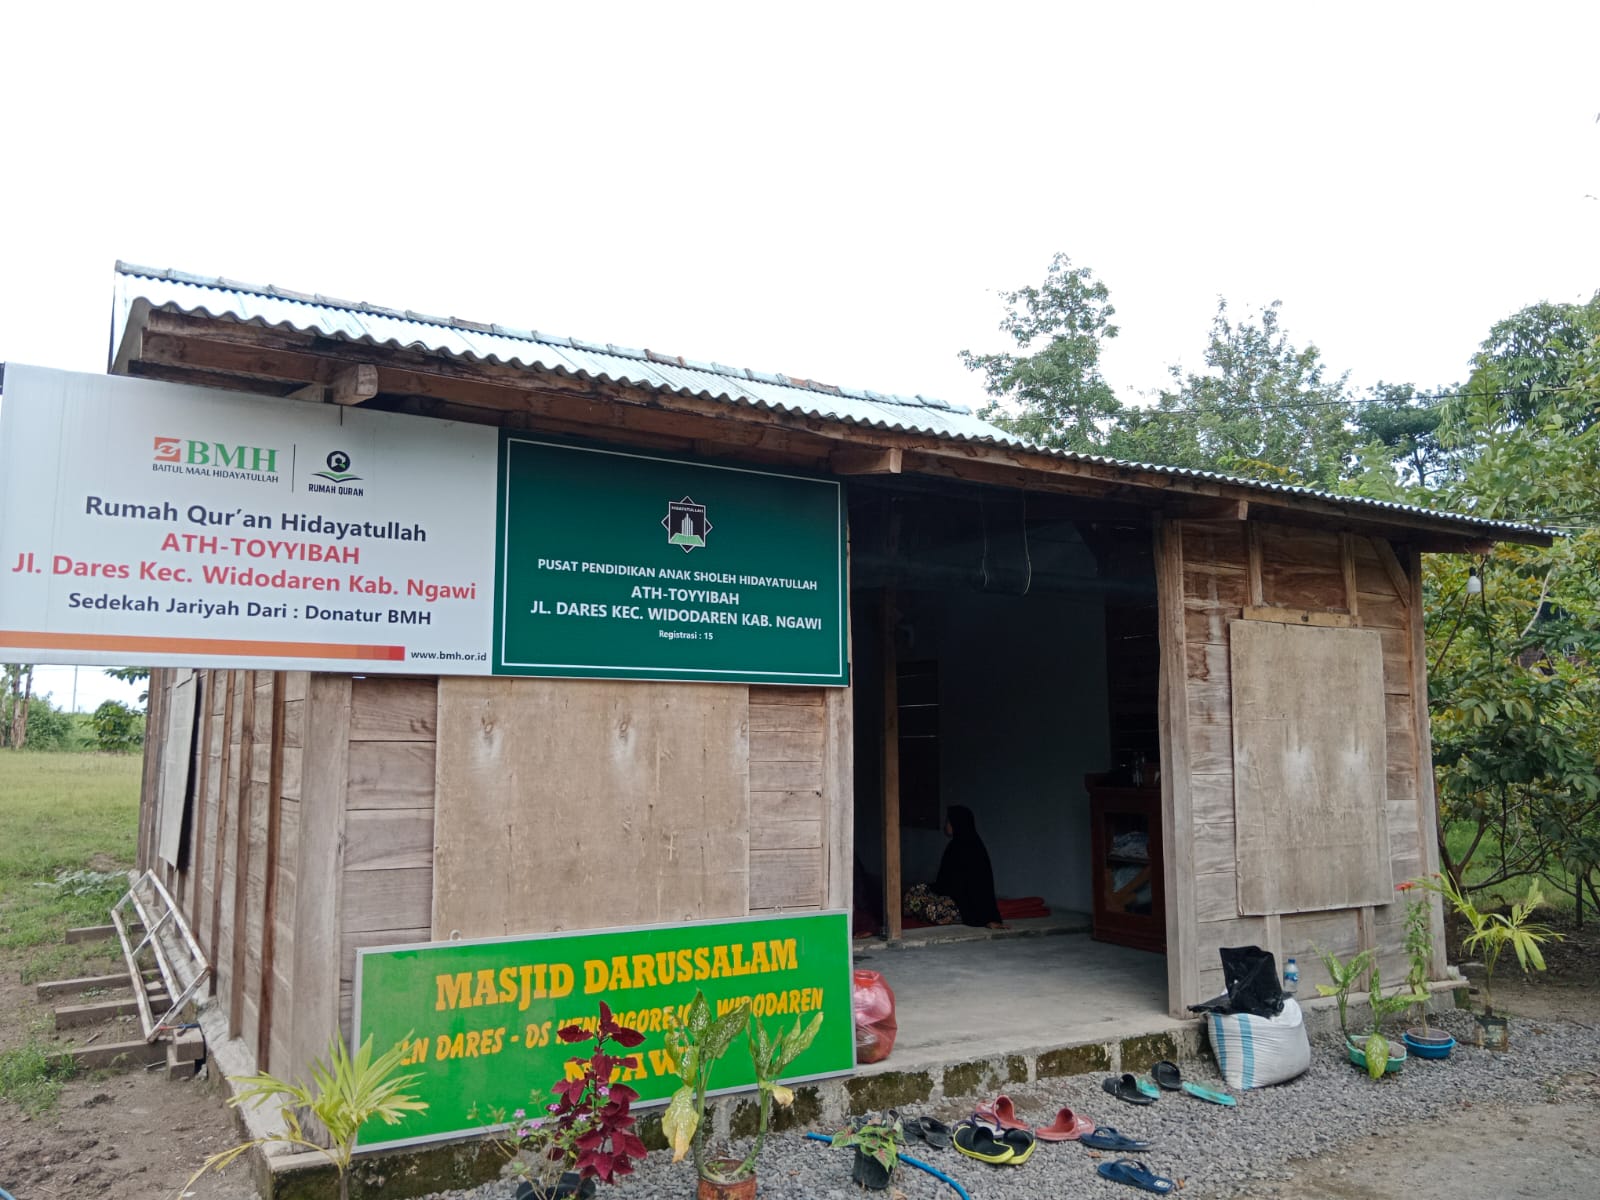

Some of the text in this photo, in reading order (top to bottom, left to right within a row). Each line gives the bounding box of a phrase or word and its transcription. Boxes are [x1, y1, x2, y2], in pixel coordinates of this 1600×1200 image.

[187, 440, 279, 473] BMH
[152, 463, 279, 484] BAITUL MAAL HIDAYATULLAH
[308, 482, 365, 497] RUMAH QURAN
[85, 495, 178, 521] Rumah
[280, 513, 426, 542] Hidayatullah
[161, 533, 361, 564] ATH-TOYYIBAH
[11, 551, 477, 603] Jl. Dares Kec. Widodaren Kab. Ngawi
[537, 558, 818, 591] PUSAT PENDIDIKAN ANAK SHOLEH HIDAYATULLAH
[68, 592, 431, 625] Sedekah Jariyah Dari : Donatur BMH
[630, 585, 740, 606] ATH-TOYYIBAH
[530, 600, 822, 630] JL. DARES KEC. WIDODAREN KAB. NGAWI
[658, 629, 698, 641] Registrasi
[703, 631, 714, 640] 15
[410, 650, 487, 662] www.bmh.or.id
[435, 938, 798, 1011] MASJID DARUSSALAM
[435, 1026, 507, 1061] DARES
[524, 1020, 553, 1050] DS
